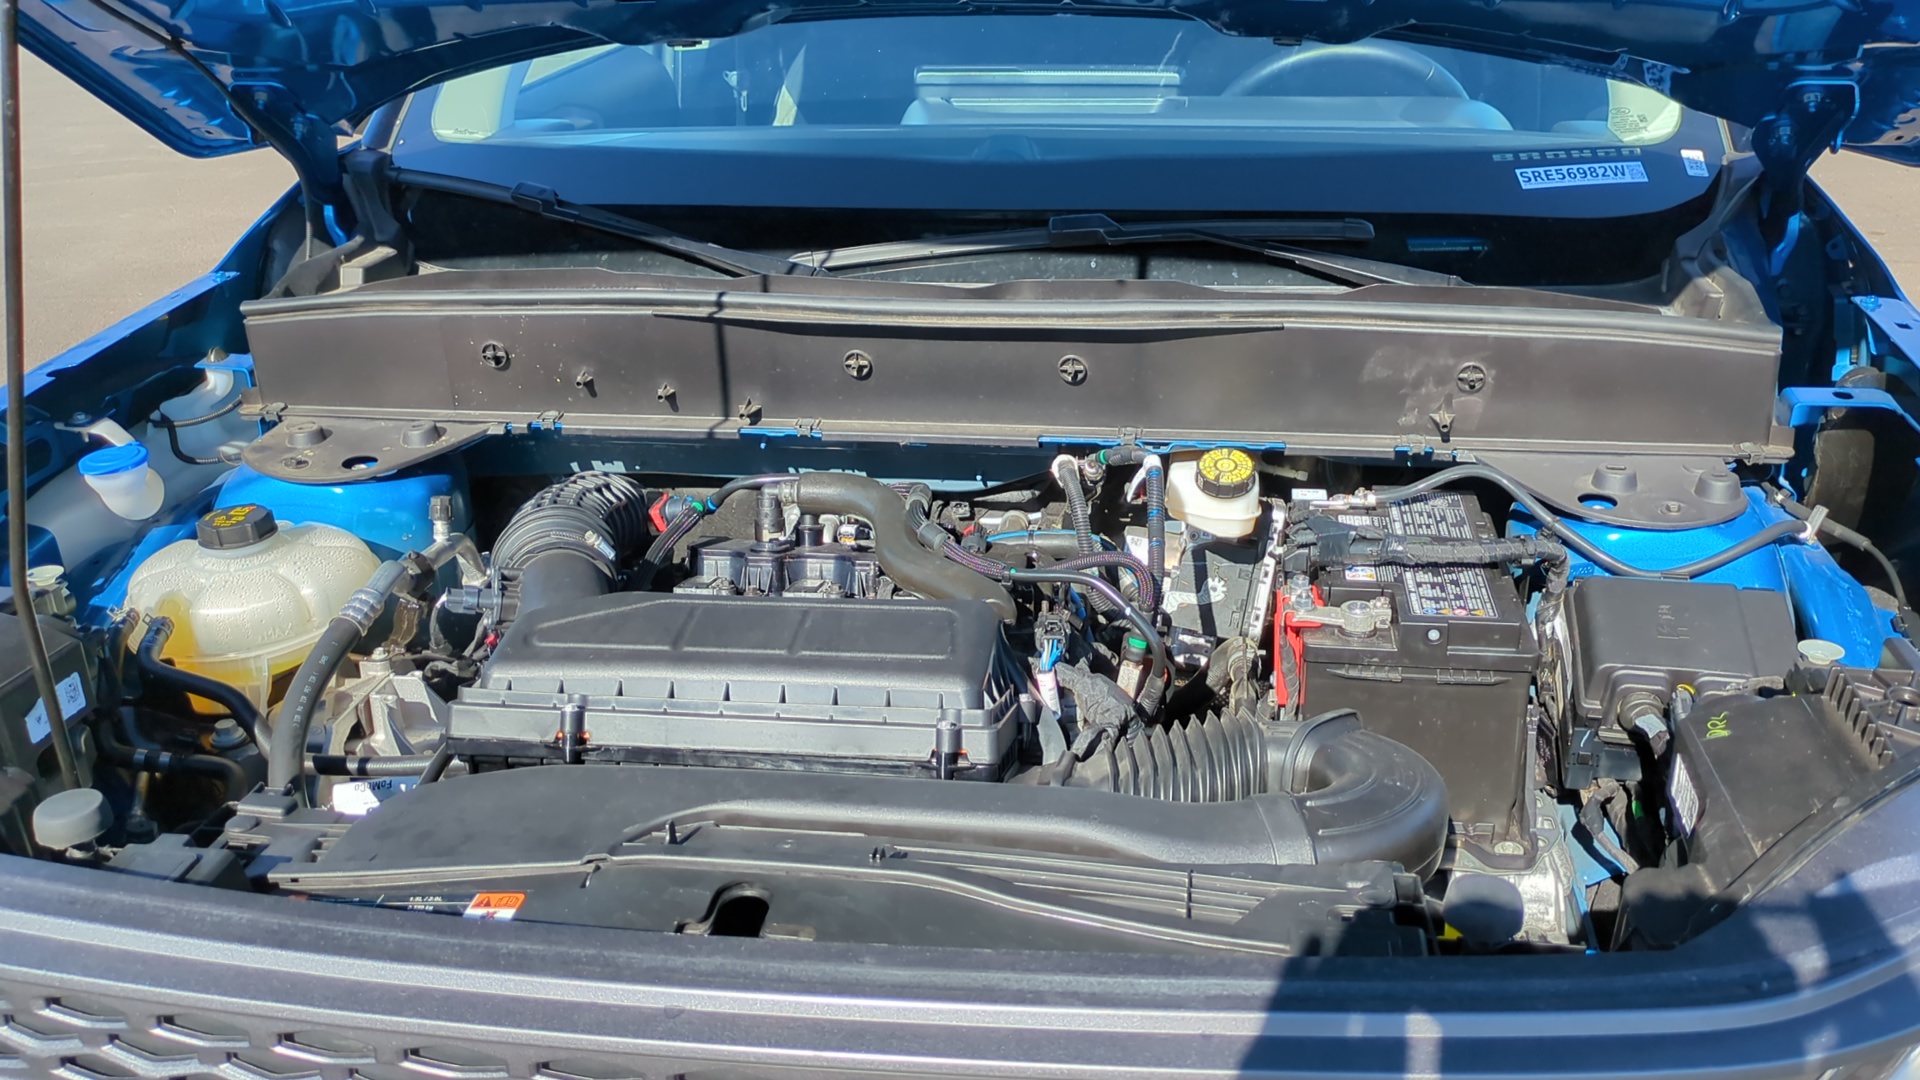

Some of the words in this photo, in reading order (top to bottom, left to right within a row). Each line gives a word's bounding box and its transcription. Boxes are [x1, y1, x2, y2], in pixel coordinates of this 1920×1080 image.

[1492, 148, 1641, 161] BRONCO
[1519, 164, 1626, 183] SRE56982W
[354, 779, 393, 793] FoMoCo
